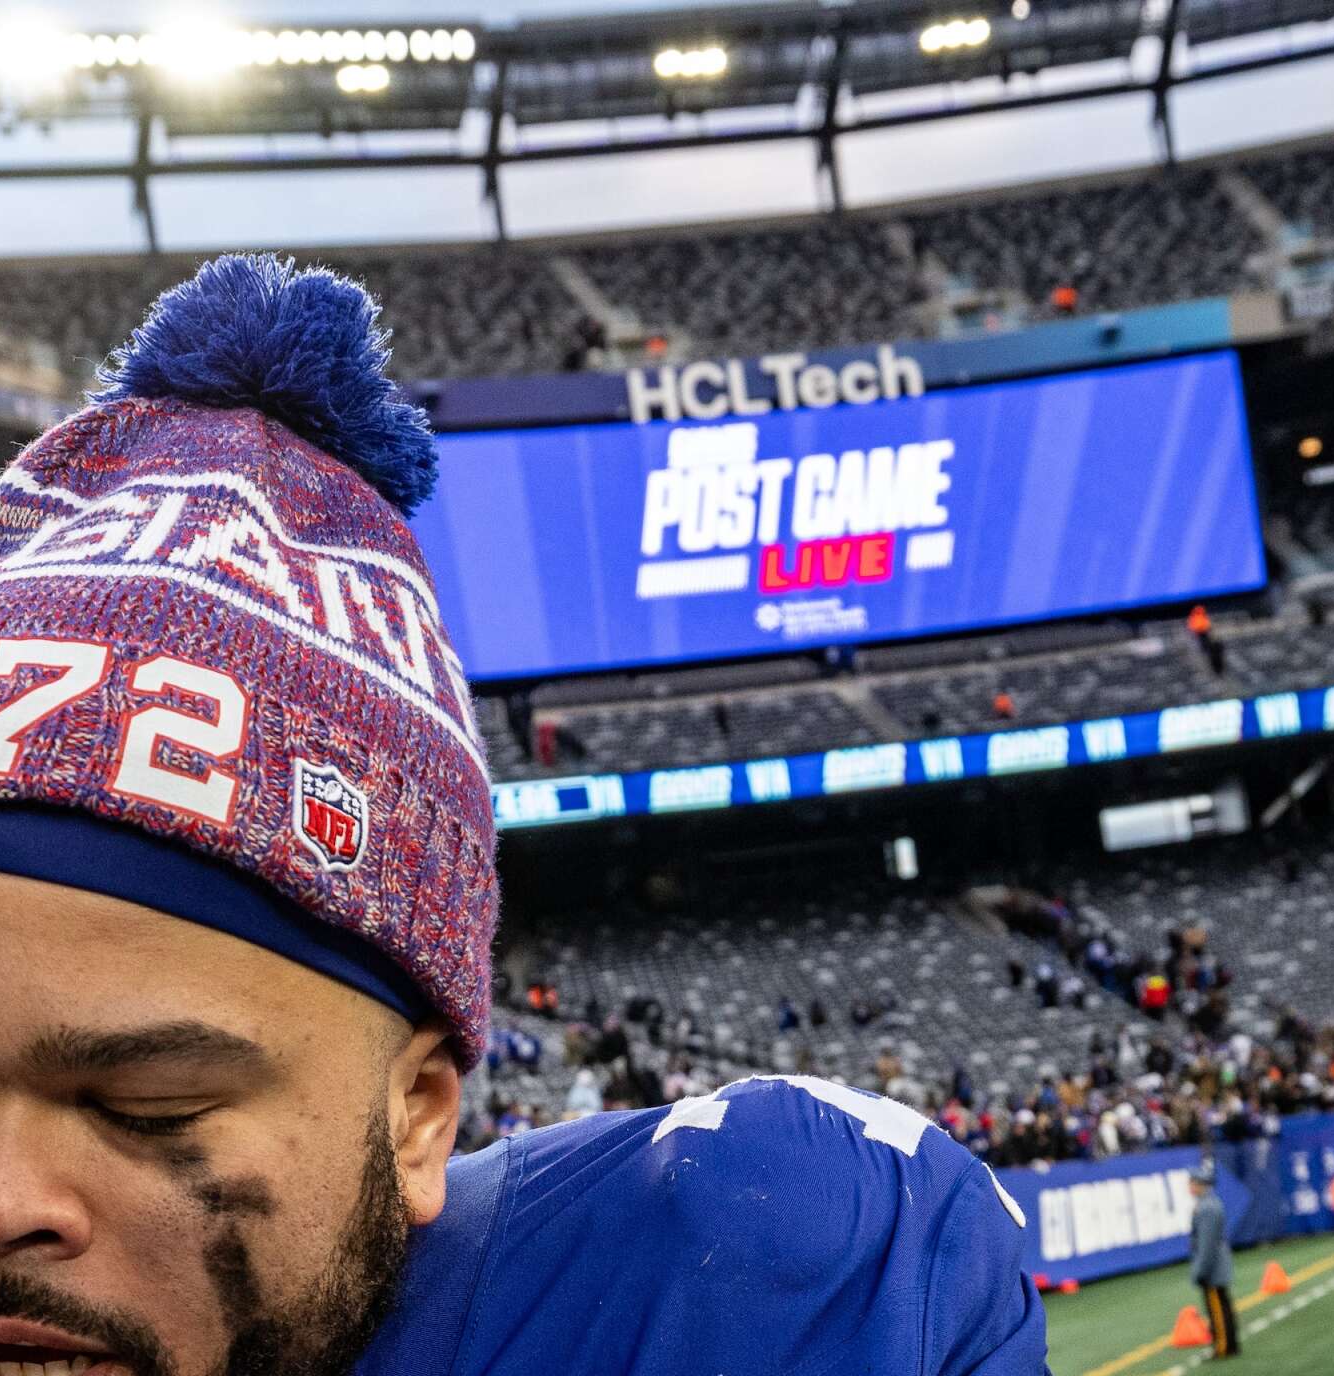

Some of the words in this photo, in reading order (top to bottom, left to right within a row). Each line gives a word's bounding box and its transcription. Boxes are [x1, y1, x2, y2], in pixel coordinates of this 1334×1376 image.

[627, 346, 924, 422] HCLTech
[760, 531, 894, 592] LIVE
[302, 796, 358, 858] NFL
